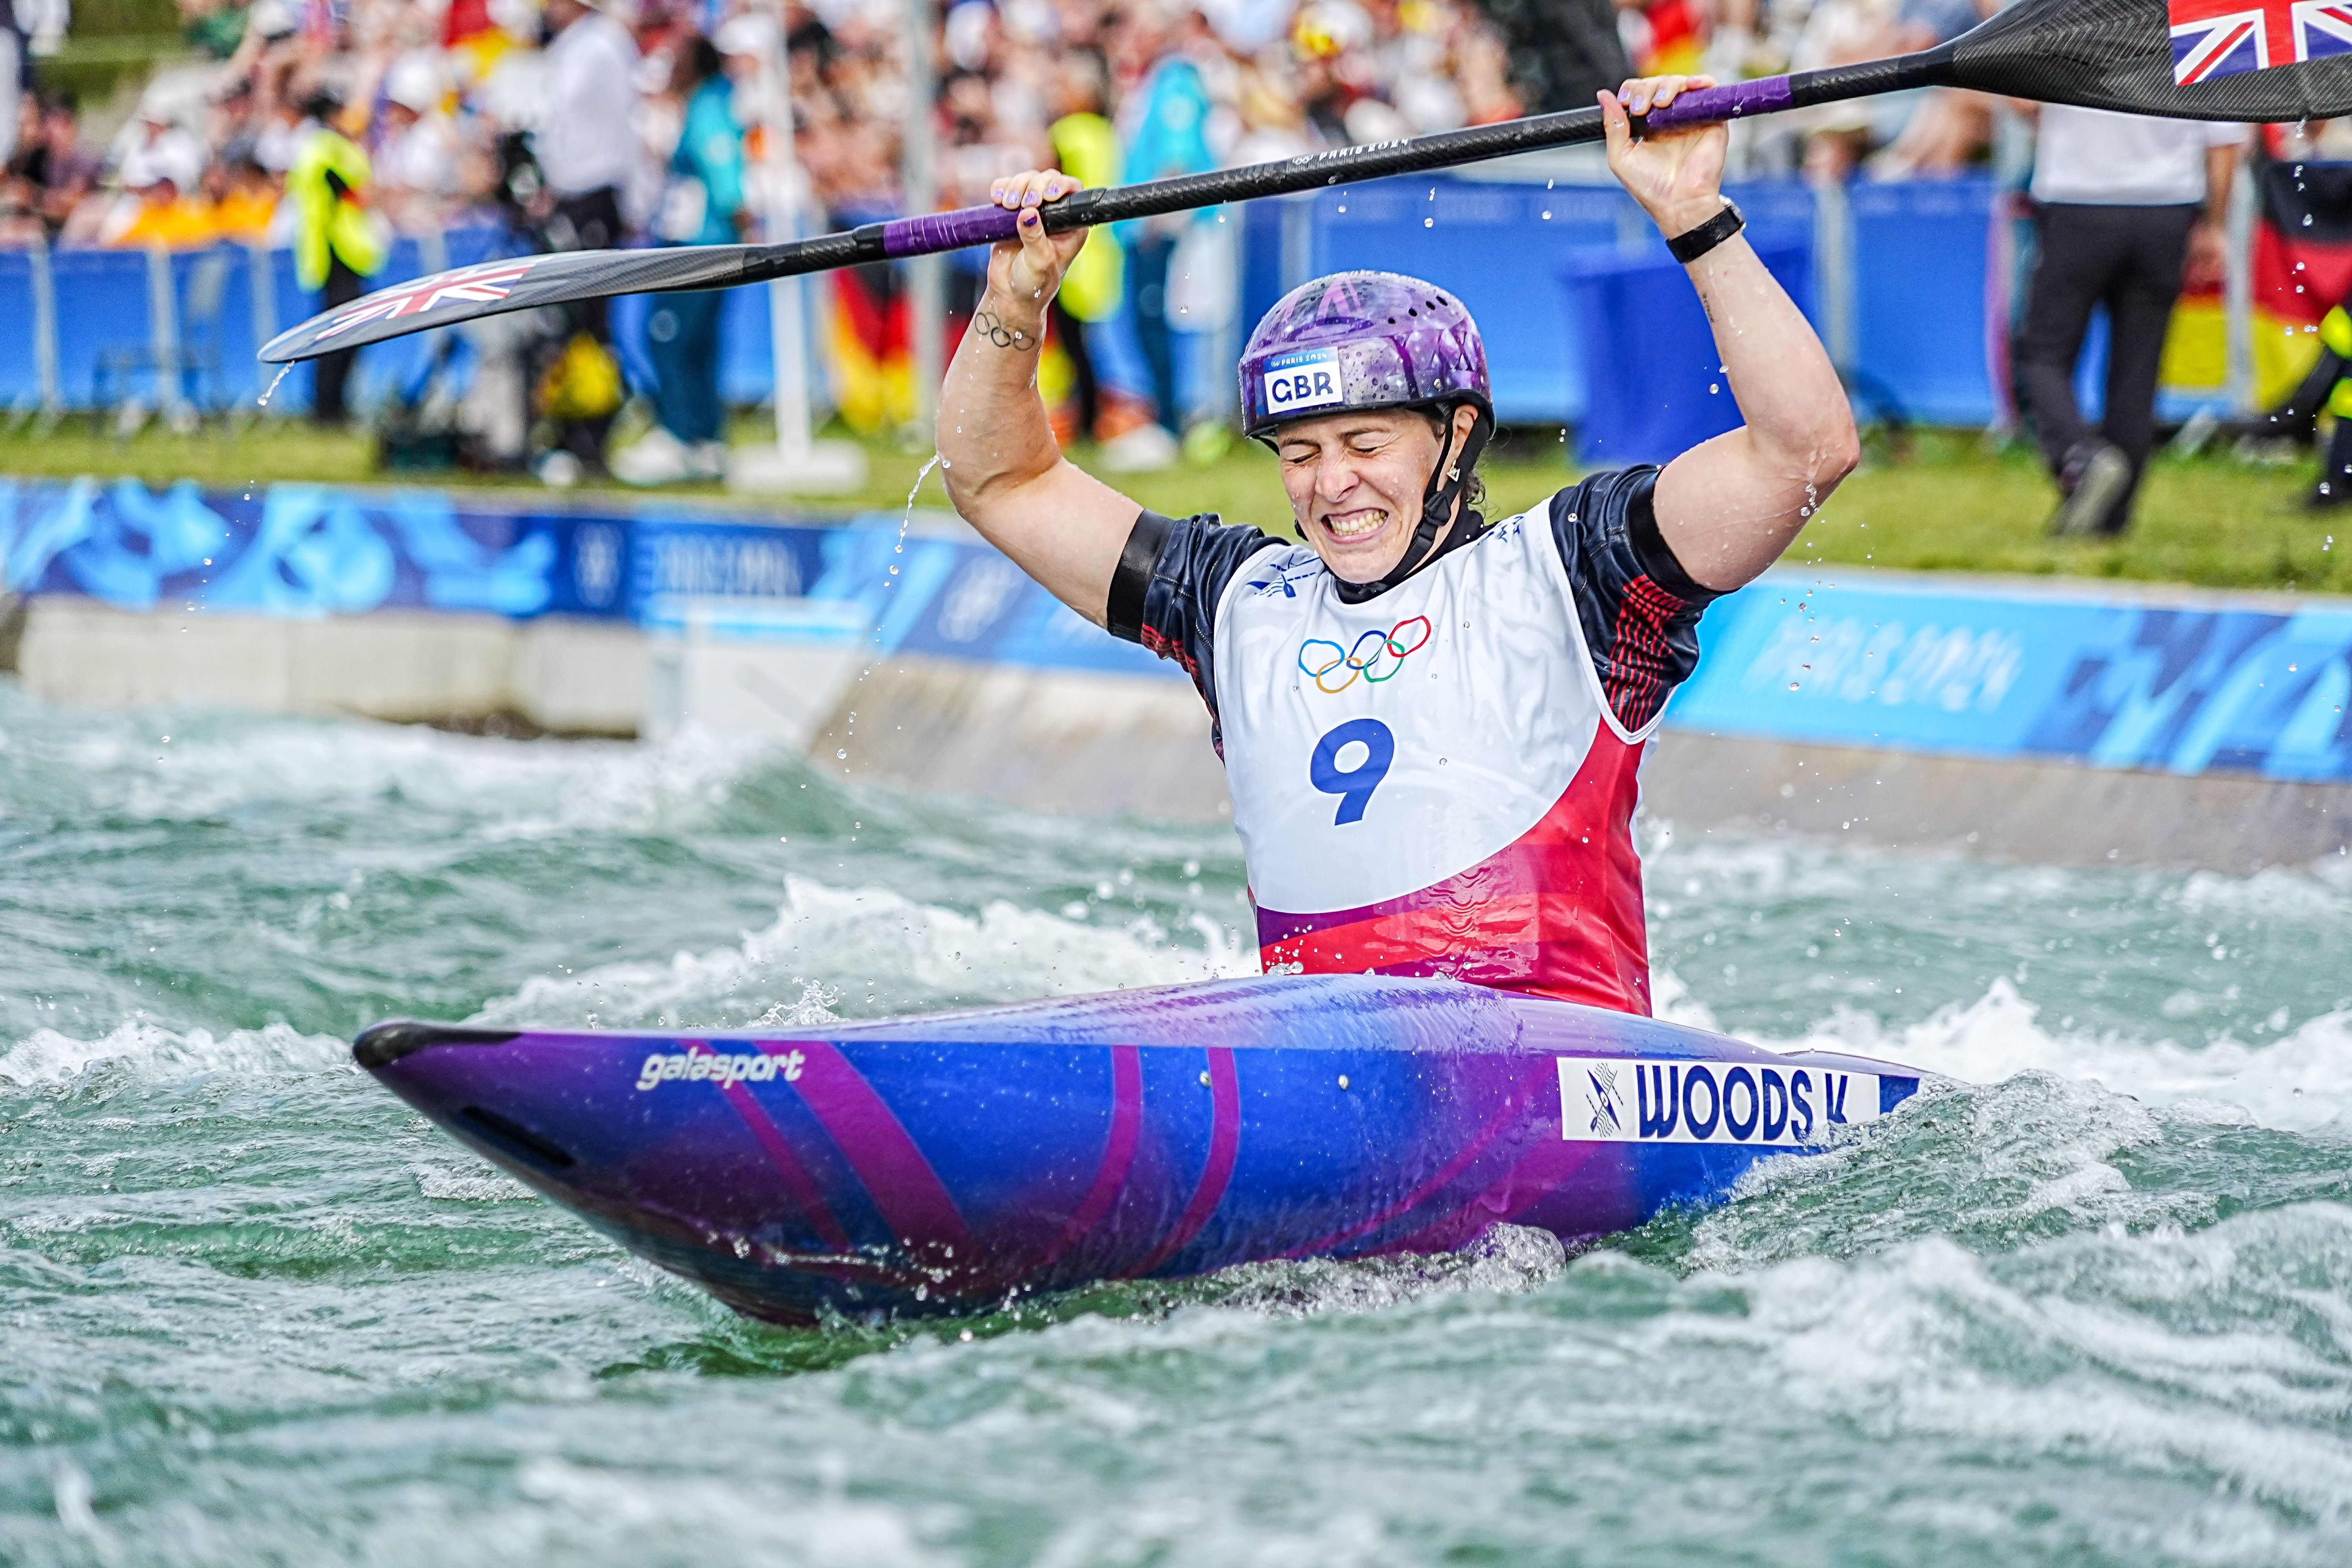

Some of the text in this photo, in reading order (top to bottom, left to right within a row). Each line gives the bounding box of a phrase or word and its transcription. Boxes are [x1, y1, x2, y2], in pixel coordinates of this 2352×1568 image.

[1281, 352, 1327, 366] PARIS 2024
[1272, 372, 1333, 402] GBR
[1310, 718, 1395, 826] 9
[635, 1045, 806, 1091] galasport
[1636, 1064, 1813, 1143] WOODS
